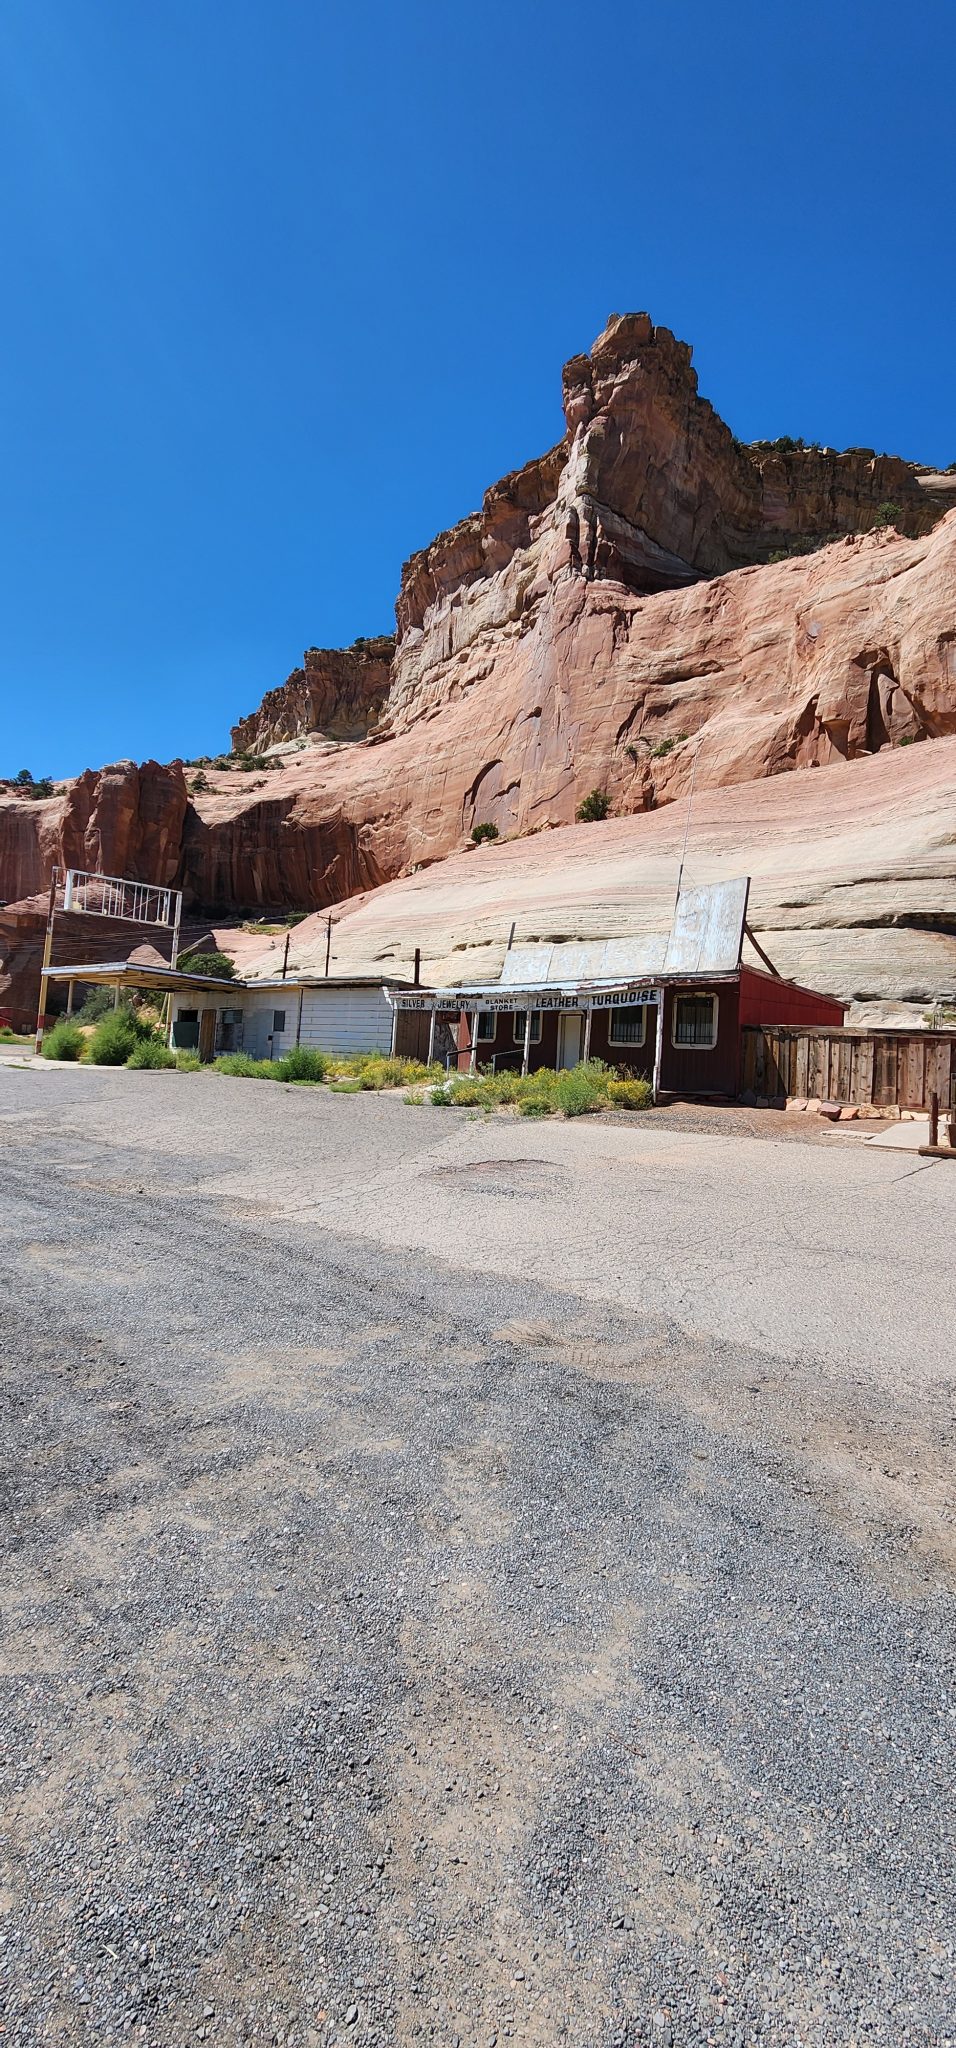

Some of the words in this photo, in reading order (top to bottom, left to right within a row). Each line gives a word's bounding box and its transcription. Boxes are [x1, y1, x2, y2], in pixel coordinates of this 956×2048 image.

[535, 996, 579, 1008] LEATHER
[591, 989, 658, 1006] TURQUOISE
[401, 999, 425, 1008] SILVER
[437, 999, 471, 1009] JEWELRY
